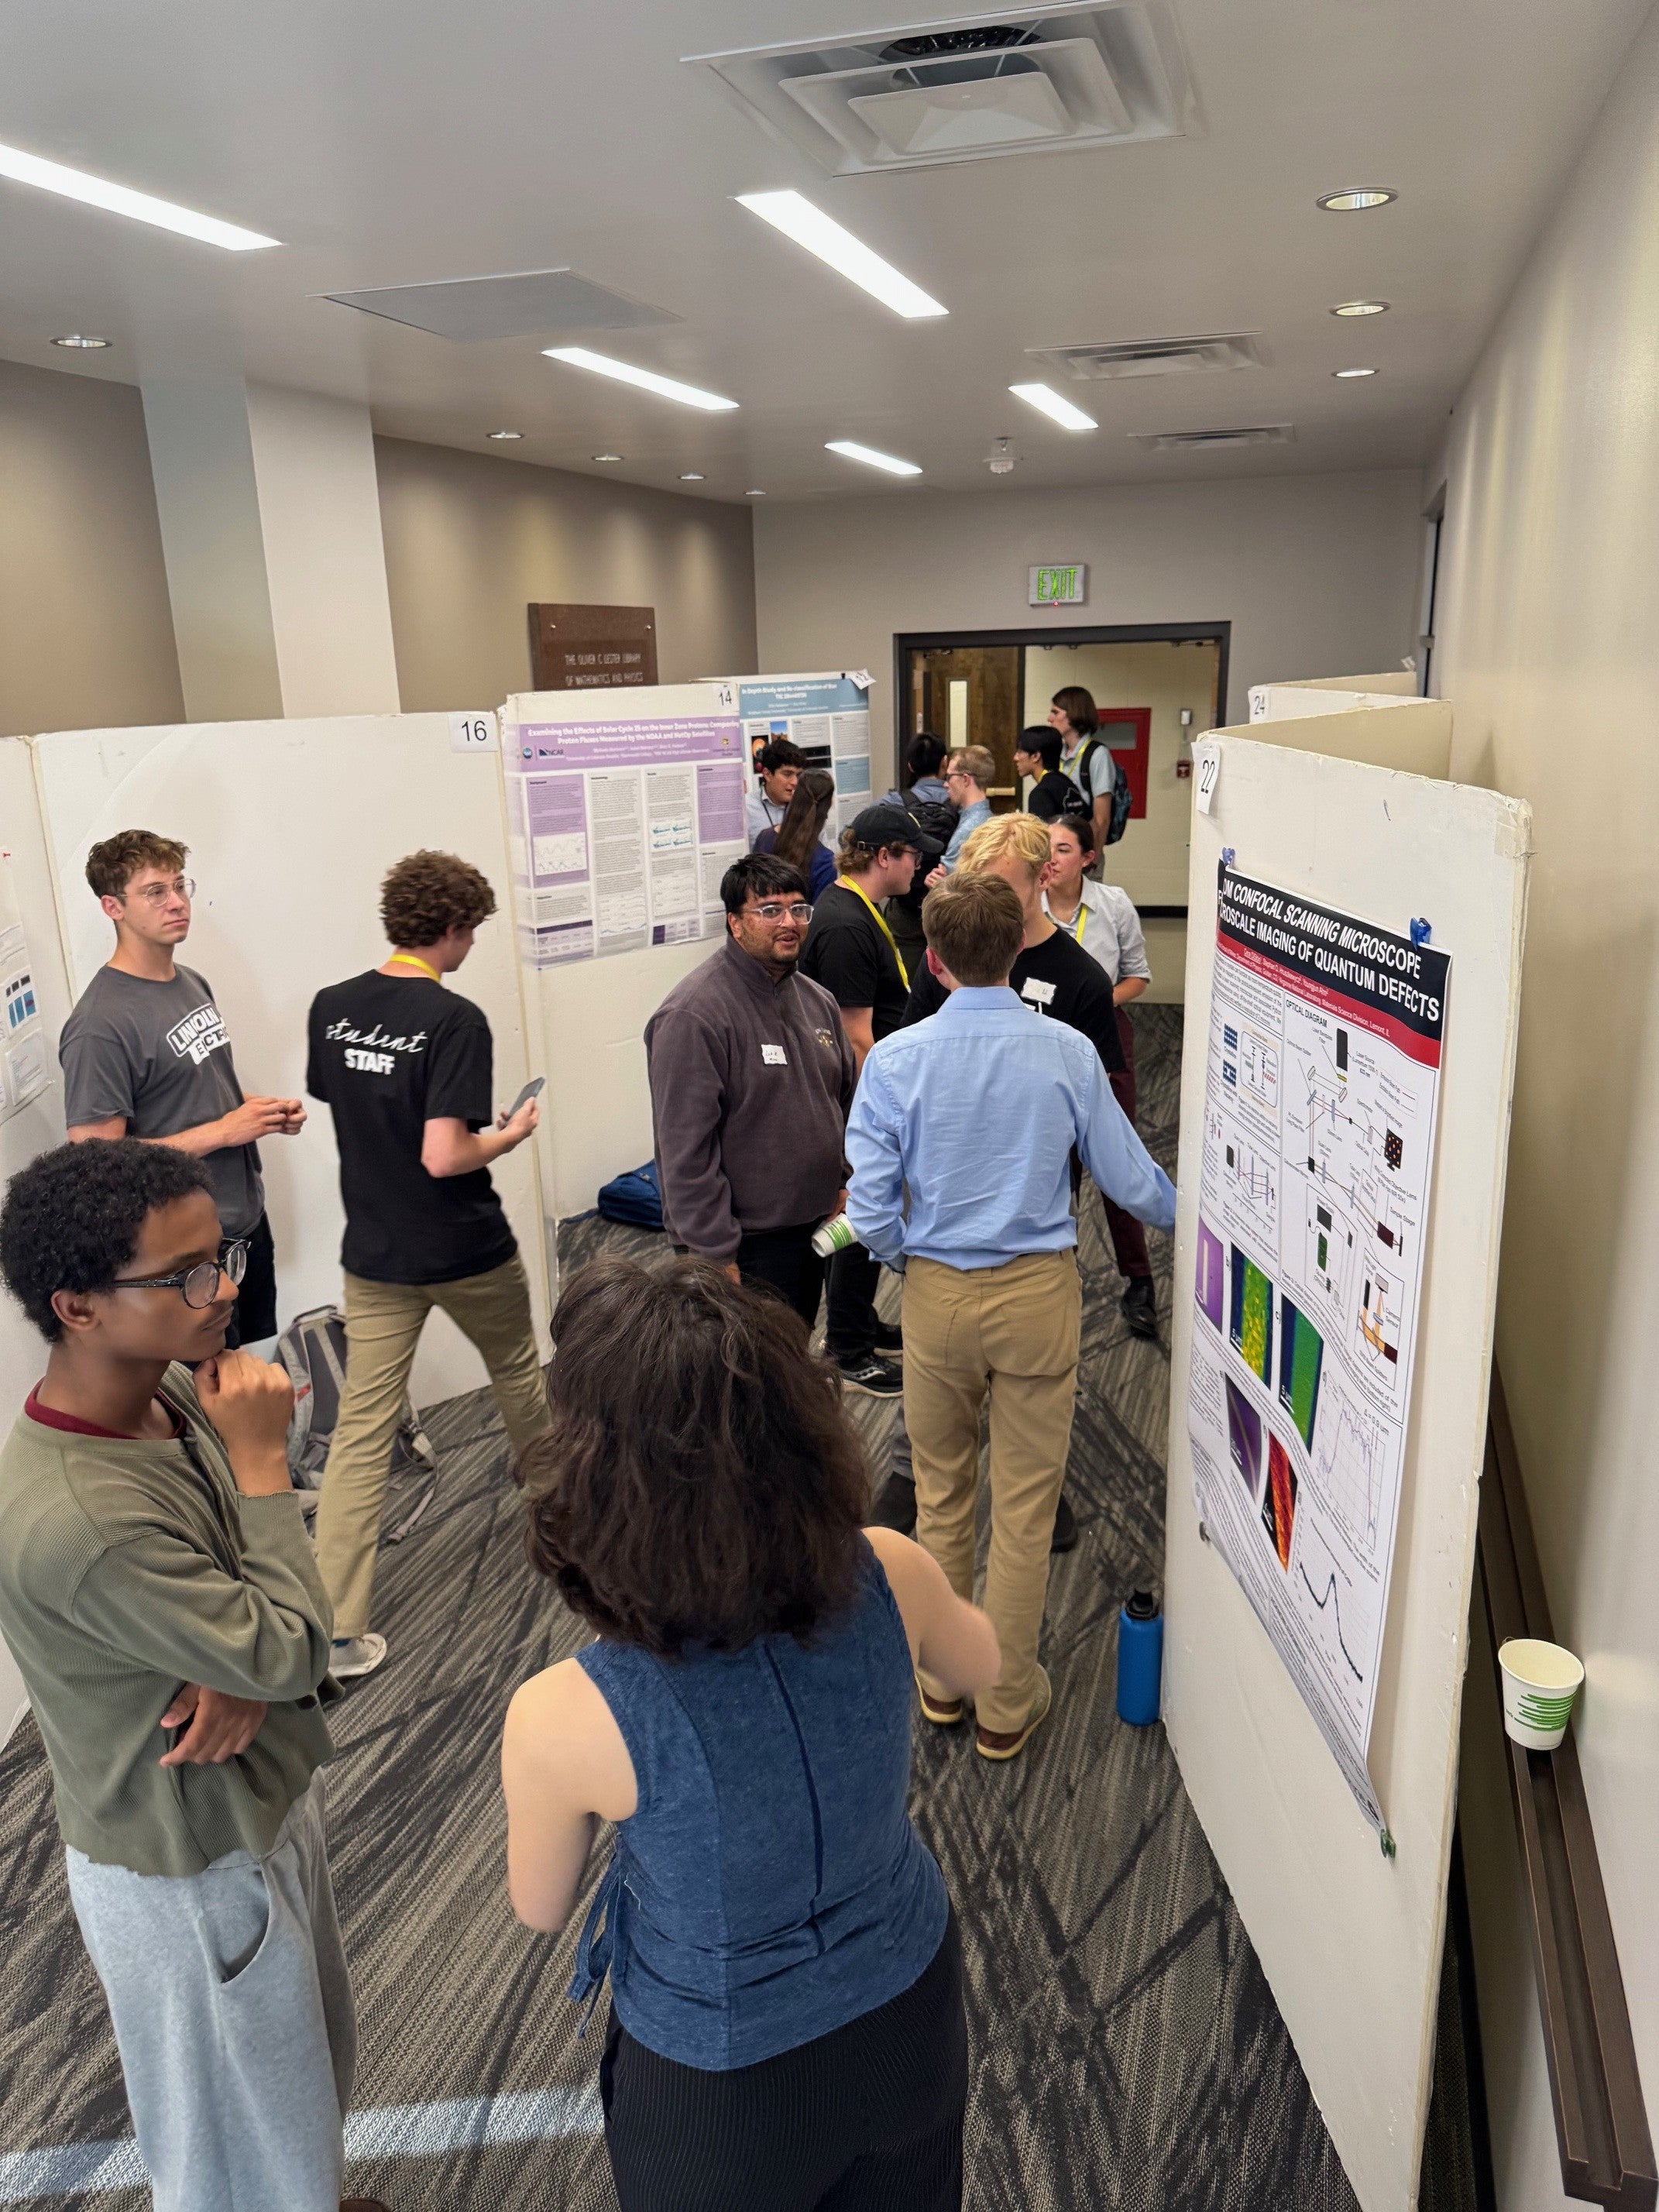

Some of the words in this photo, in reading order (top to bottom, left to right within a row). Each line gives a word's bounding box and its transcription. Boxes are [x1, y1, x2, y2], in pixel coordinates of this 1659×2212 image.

[1037, 568, 1077, 600] EXIT
[719, 690, 732, 706] 14
[1254, 696, 1266, 715] 24
[462, 720, 487, 741] 16
[1200, 760, 1215, 794] 22
[1234, 884, 1284, 920] CONFOCAL
[1283, 904, 1341, 943] SCANNING
[1338, 926, 1422, 980] MICROSCOPE
[1256, 921, 1297, 956] IMAGING
[1297, 939, 1314, 962] OF
[1314, 948, 1376, 992] QUANTUM
[1379, 973, 1440, 1022] DEFECTS
[171, 1007, 220, 1051] LINOLN
[1286, 999, 1304, 1018] OPTICAL
[1304, 1009, 1328, 1029] DIAGRAM
[325, 1018, 428, 1053] student
[344, 1048, 395, 1075] STAFF
